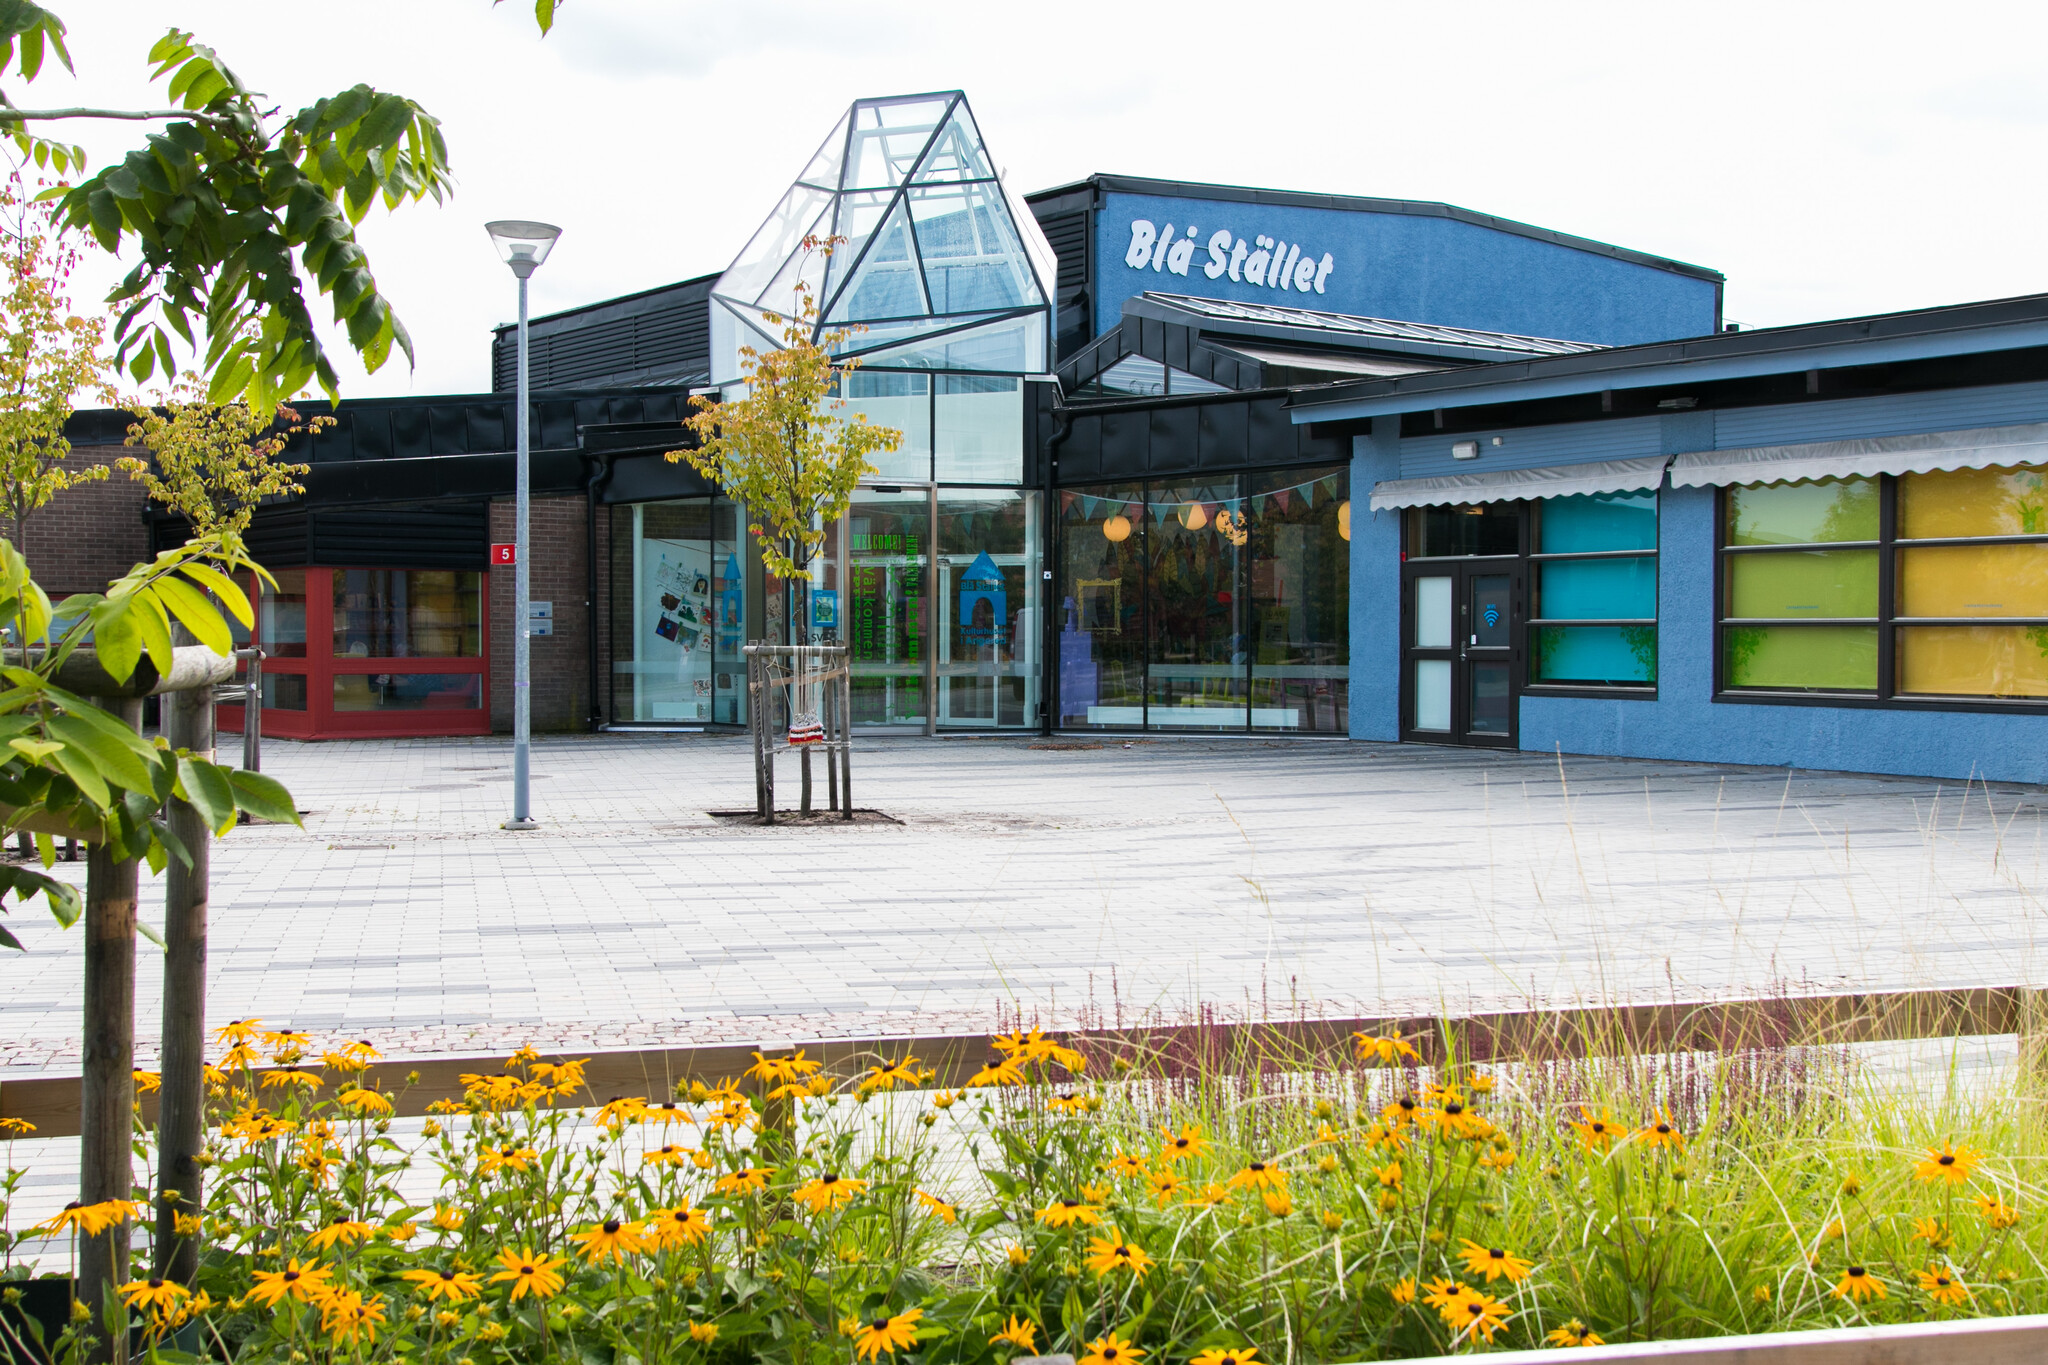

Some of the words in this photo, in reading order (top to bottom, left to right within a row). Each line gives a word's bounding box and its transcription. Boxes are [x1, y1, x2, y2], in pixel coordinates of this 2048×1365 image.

[1124, 219, 1198, 277] Blå
[1203, 229, 1334, 295] Stället
[853, 534, 902, 550] WELCOME!
[502, 548, 510, 560] 5
[976, 581, 1005, 591] Stället
